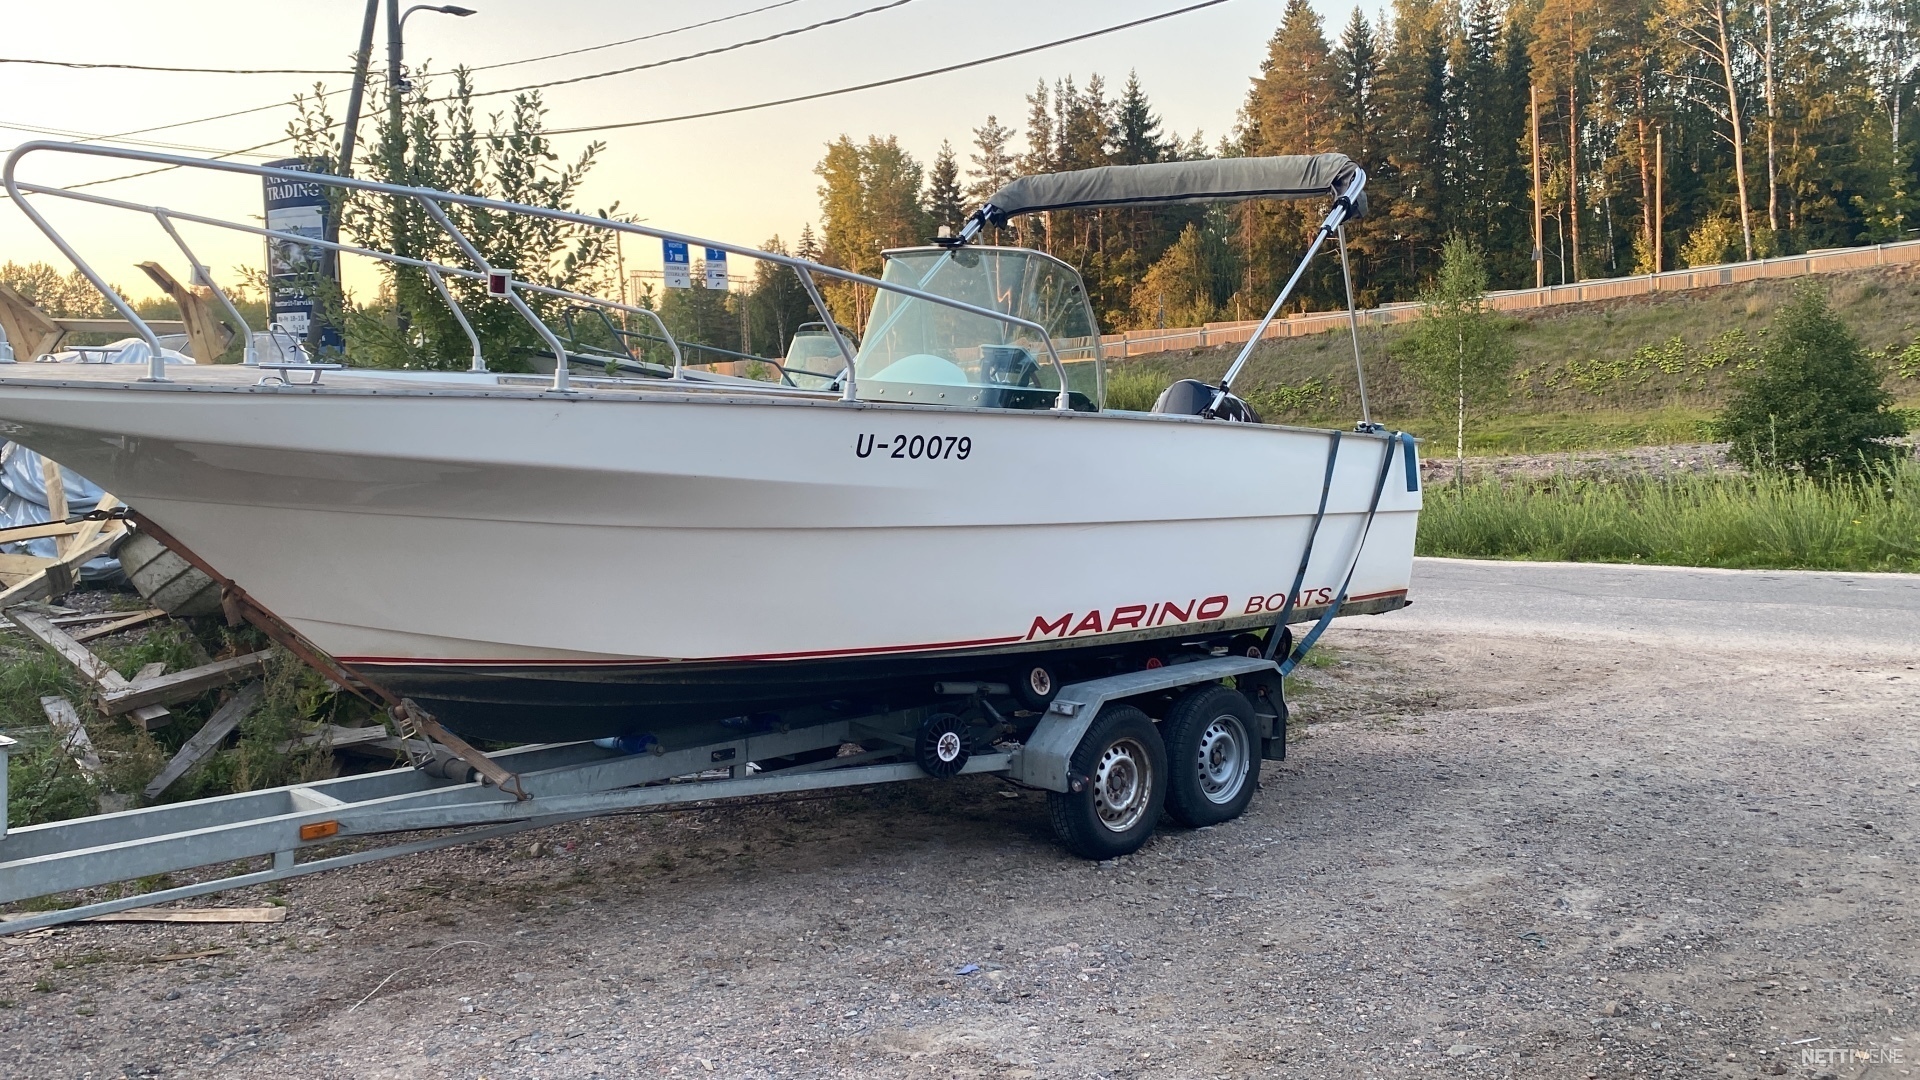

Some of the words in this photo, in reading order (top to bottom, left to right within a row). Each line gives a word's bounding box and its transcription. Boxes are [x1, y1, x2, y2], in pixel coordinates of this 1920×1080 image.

[266, 182, 320, 201] TRADING
[855, 433, 972, 461] U-20079
[1025, 594, 1229, 641] MARINO
